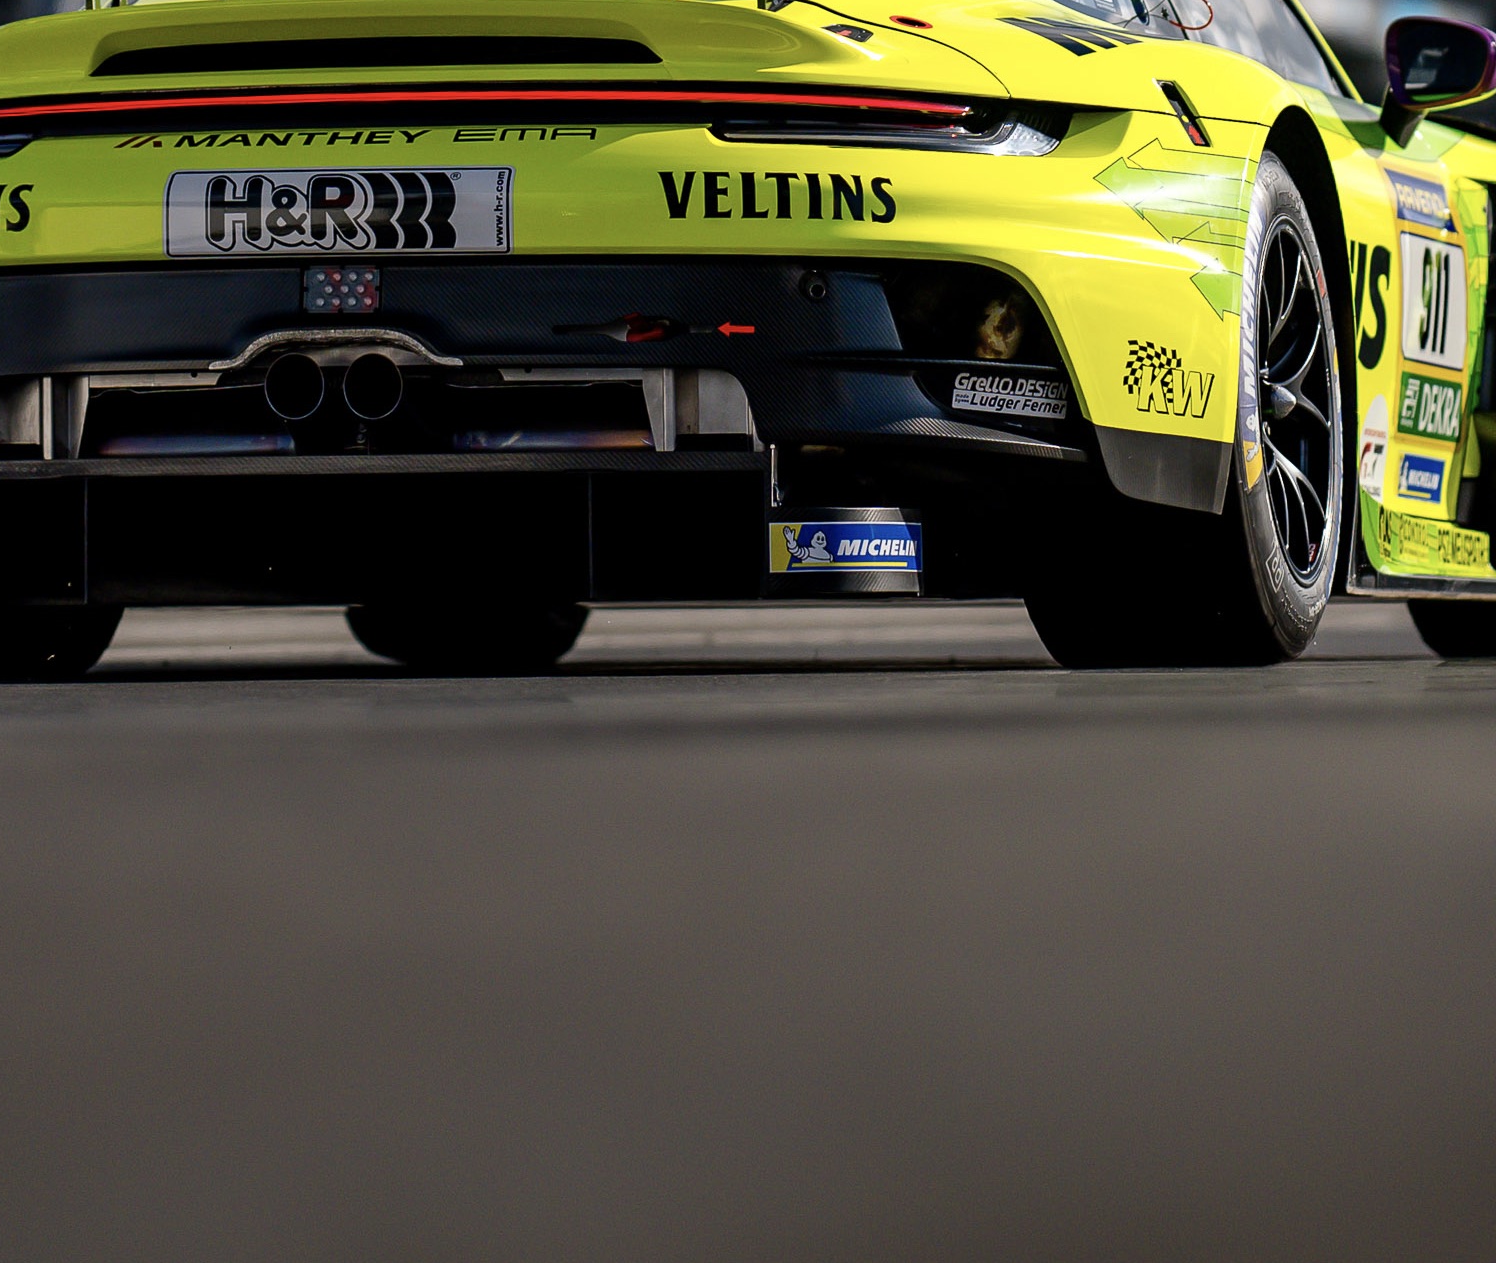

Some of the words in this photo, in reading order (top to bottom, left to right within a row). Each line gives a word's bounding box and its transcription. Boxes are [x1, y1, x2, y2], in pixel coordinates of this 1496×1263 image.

[174, 129, 432, 149] MANTHEY
[452, 127, 597, 143] EMA
[205, 173, 371, 251] H&R
[493, 170, 505, 247] www.h-r.com
[657, 170, 897, 224] VELTINS
[1419, 246, 1450, 355] 911
[969, 392, 1022, 412] Ludger
[1022, 399, 1066, 416] Ferner
[1136, 365, 1215, 419] KW
[1417, 382, 1461, 438] DEKRA
[837, 539, 917, 557] MICHELIN
